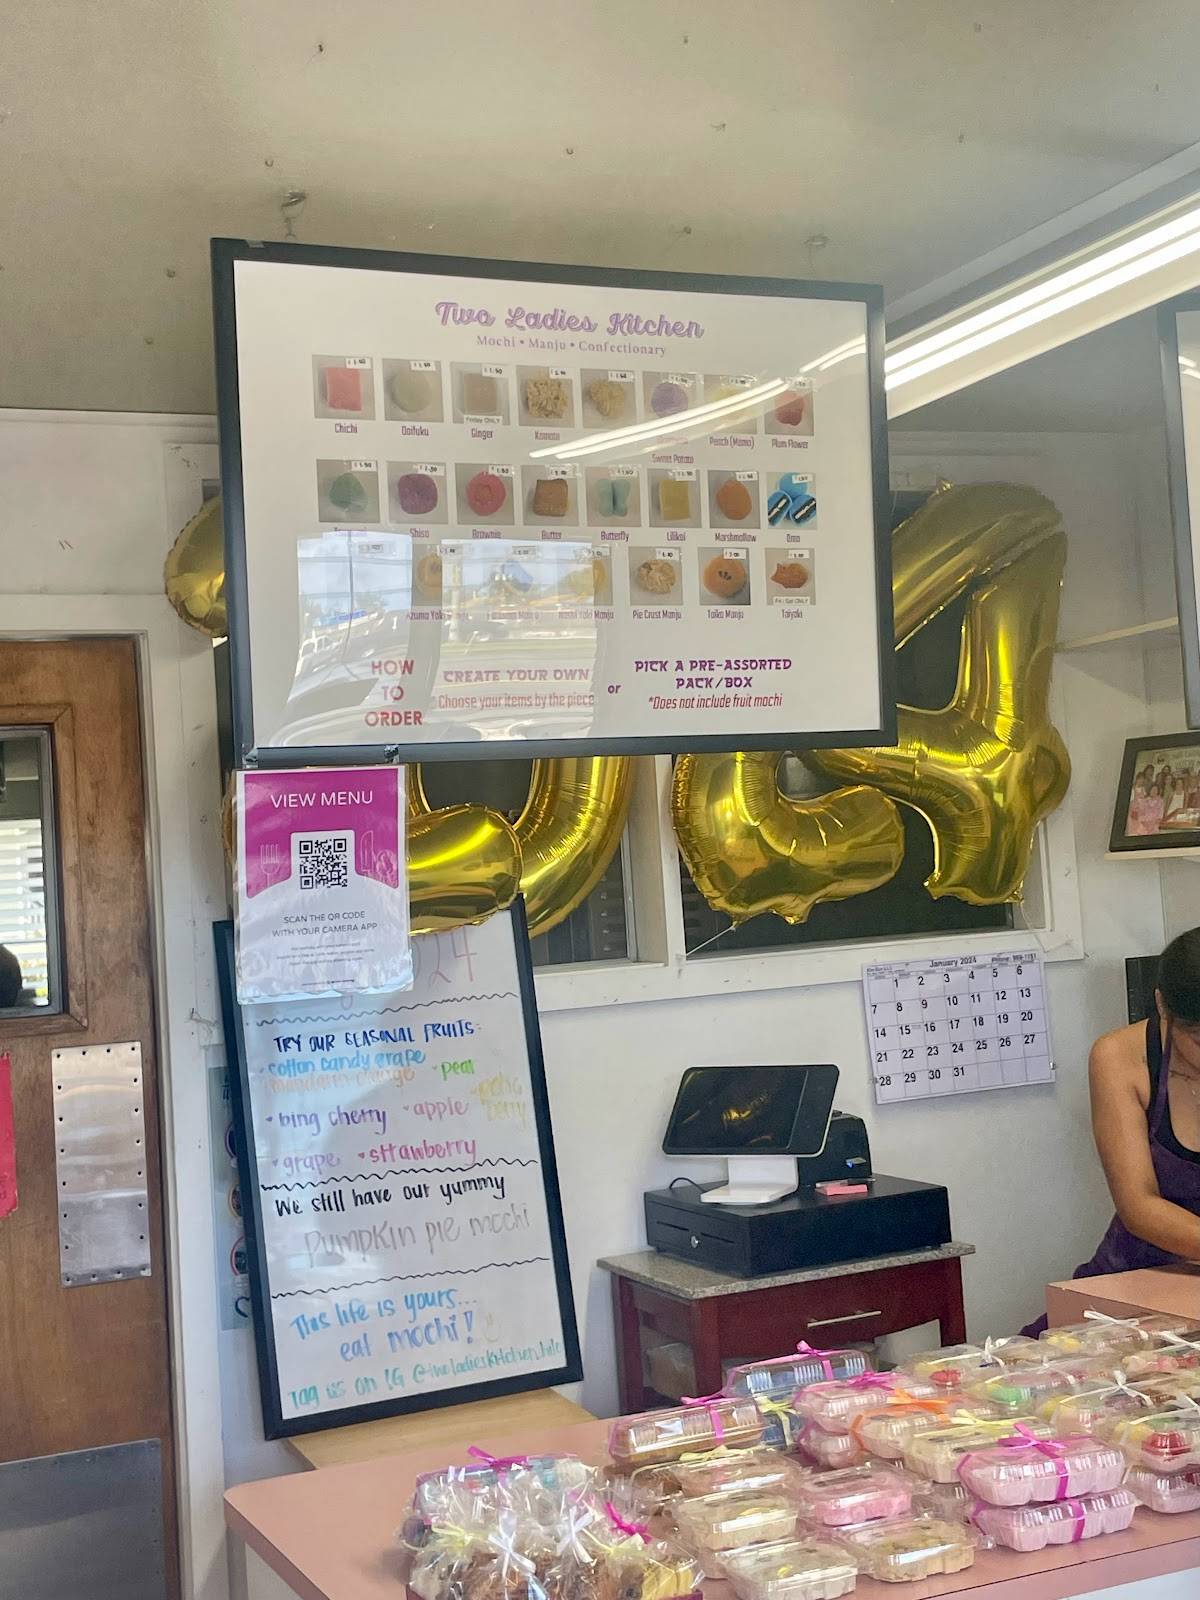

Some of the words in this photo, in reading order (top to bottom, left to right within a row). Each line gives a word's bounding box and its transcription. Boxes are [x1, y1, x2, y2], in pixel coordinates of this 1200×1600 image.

[435, 301, 496, 327] Two
[504, 306, 598, 332] Ladies
[606, 312, 705, 338] Kitchen
[476, 335, 516, 347] Mochi
[528, 337, 566, 351] Manju
[578, 340, 667, 358] Confectionary
[471, 428, 494, 440] Ginger
[772, 439, 787, 448] Plum
[788, 439, 808, 449] Flower
[410, 528, 430, 538] Shiso
[601, 531, 630, 542] Butterfly
[667, 532, 686, 542] Lilikoi
[715, 533, 757, 543] Marshmallow
[594, 610, 614, 621] Manju
[633, 610, 643, 619] Pie
[644, 609, 661, 619] Crust
[662, 610, 682, 621] Manju
[725, 610, 744, 620] Manju
[782, 609, 803, 620] Taiyaki
[371, 659, 414, 675] HOW
[635, 660, 669, 673] PICK
[675, 660, 684, 672] A
[689, 659, 792, 672] PRE-ASSORTED
[443, 670, 500, 683] CREATE
[507, 669, 548, 682] YOUR
[553, 668, 590, 681] OWN
[382, 685, 404, 701] TO
[607, 684, 622, 694] or
[438, 695, 477, 708] Choose
[479, 696, 502, 710] your
[504, 694, 532, 707] items
[533, 694, 546, 709] by
[549, 693, 565, 706] the
[567, 693, 595, 708] piece
[678, 695, 695, 709] not
[697, 694, 731, 708] include
[732, 694, 752, 708] fruit
[753, 693, 783, 707] mochi
[364, 711, 423, 727] ORDER
[270, 792, 316, 808] VIEW
[321, 790, 373, 807] MENU
[283, 914, 308, 924] SCAN
[310, 913, 326, 922] THE
[327, 912, 341, 922] QR
[342, 910, 366, 920] CODE
[272, 929, 295, 937] WITH
[297, 926, 320, 936] YOUR
[322, 925, 359, 934] CAMERA
[361, 922, 378, 931] APP
[929, 958, 958, 968] January
[960, 956, 977, 966] 2024
[894, 979, 899, 988] 1
[918, 976, 925, 986] 2
[944, 973, 950, 983] 3
[969, 971, 975, 980] 4
[992, 968, 998, 978] 5
[1016, 965, 1023, 975] 6
[872, 1005, 877, 1014] 7
[896, 1002, 903, 1012] 8
[921, 999, 928, 1009] 9
[947, 996, 958, 1006] 10
[970, 994, 981, 1003] 11
[995, 990, 1007, 1001] 12
[1020, 988, 1031, 998] 13
[875, 1027, 886, 1038] 14
[899, 1025, 911, 1035] 15
[924, 1022, 936, 1032] 16
[949, 1019, 960, 1029] 17
[973, 1017, 984, 1027] 18
[997, 1013, 1009, 1024] 19
[1021, 1011, 1033, 1021] 20
[274, 1034, 301, 1053] TRY
[309, 1032, 335, 1052] OUR
[345, 1027, 416, 1048] SEASONAL
[876, 1052, 888, 1062] 21
[902, 1049, 914, 1059] 22
[927, 1046, 939, 1056] 23
[952, 1043, 964, 1053] 24
[975, 1040, 988, 1050] 25
[999, 1037, 1012, 1047] 26
[1023, 1034, 1035, 1044] 27
[268, 1058, 315, 1078] cotton
[320, 1050, 370, 1074] candy
[374, 1048, 426, 1070] grape
[440, 1058, 476, 1081] pear
[879, 1076, 892, 1087] 28
[904, 1072, 917, 1083] 29
[928, 1069, 941, 1080] 30
[953, 1066, 965, 1077] 31
[413, 1099, 471, 1121] apple
[278, 1111, 321, 1136] bing
[329, 1105, 387, 1135] cherry
[369, 1138, 478, 1167] strawberry
[284, 1151, 341, 1177] grape
[275, 1199, 303, 1217] We
[311, 1189, 345, 1213] still
[352, 1187, 392, 1208] have
[403, 1184, 430, 1201] our
[440, 1176, 505, 1206] yummy
[425, 1216, 461, 1254] pie
[470, 1202, 530, 1236] mochi
[290, 1314, 330, 1340] This
[335, 1299, 369, 1328] life
[377, 1298, 395, 1318] is
[339, 1332, 372, 1362] eat
[289, 1385, 320, 1409] Tag
[326, 1380, 346, 1399] us
[355, 1375, 378, 1396] on
[384, 1367, 405, 1392] IG
